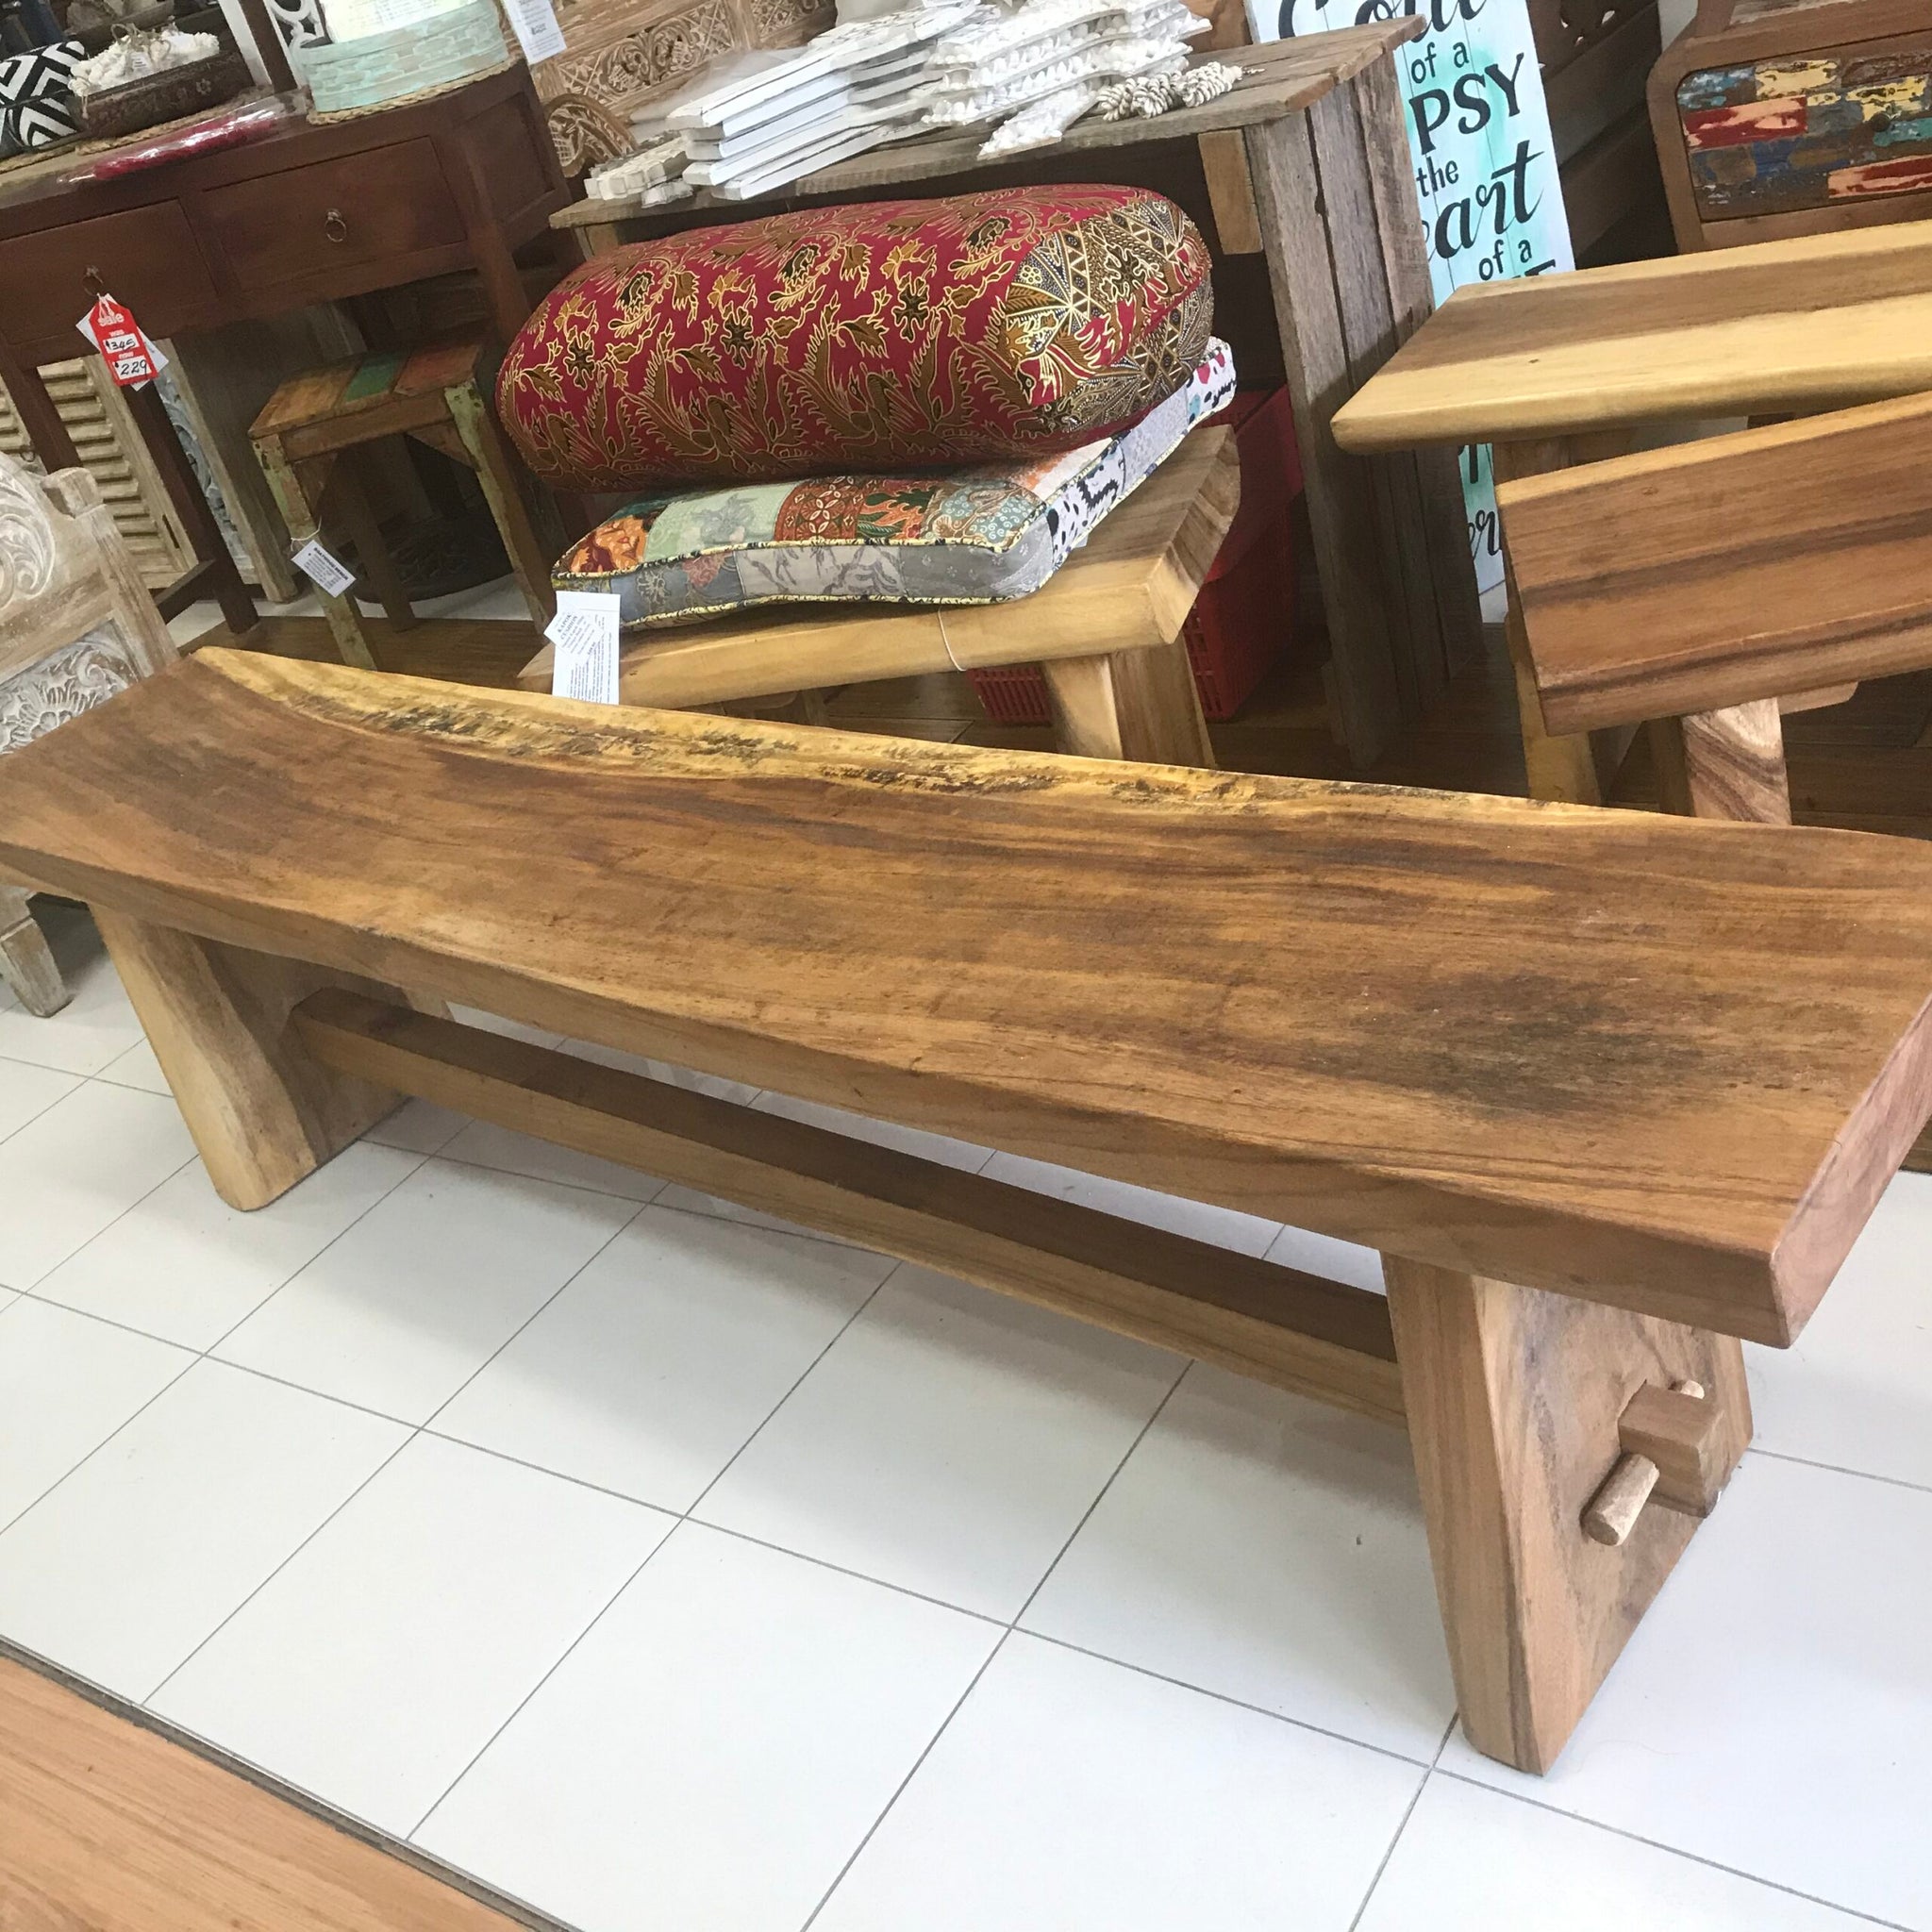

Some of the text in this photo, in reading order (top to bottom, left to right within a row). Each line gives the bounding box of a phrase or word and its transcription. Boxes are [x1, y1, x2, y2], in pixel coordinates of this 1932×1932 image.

[1410, 42, 1470, 84] of a
[1416, 157, 1459, 197] the
[1478, 240, 1504, 281] of
[1517, 240, 1533, 263] a
